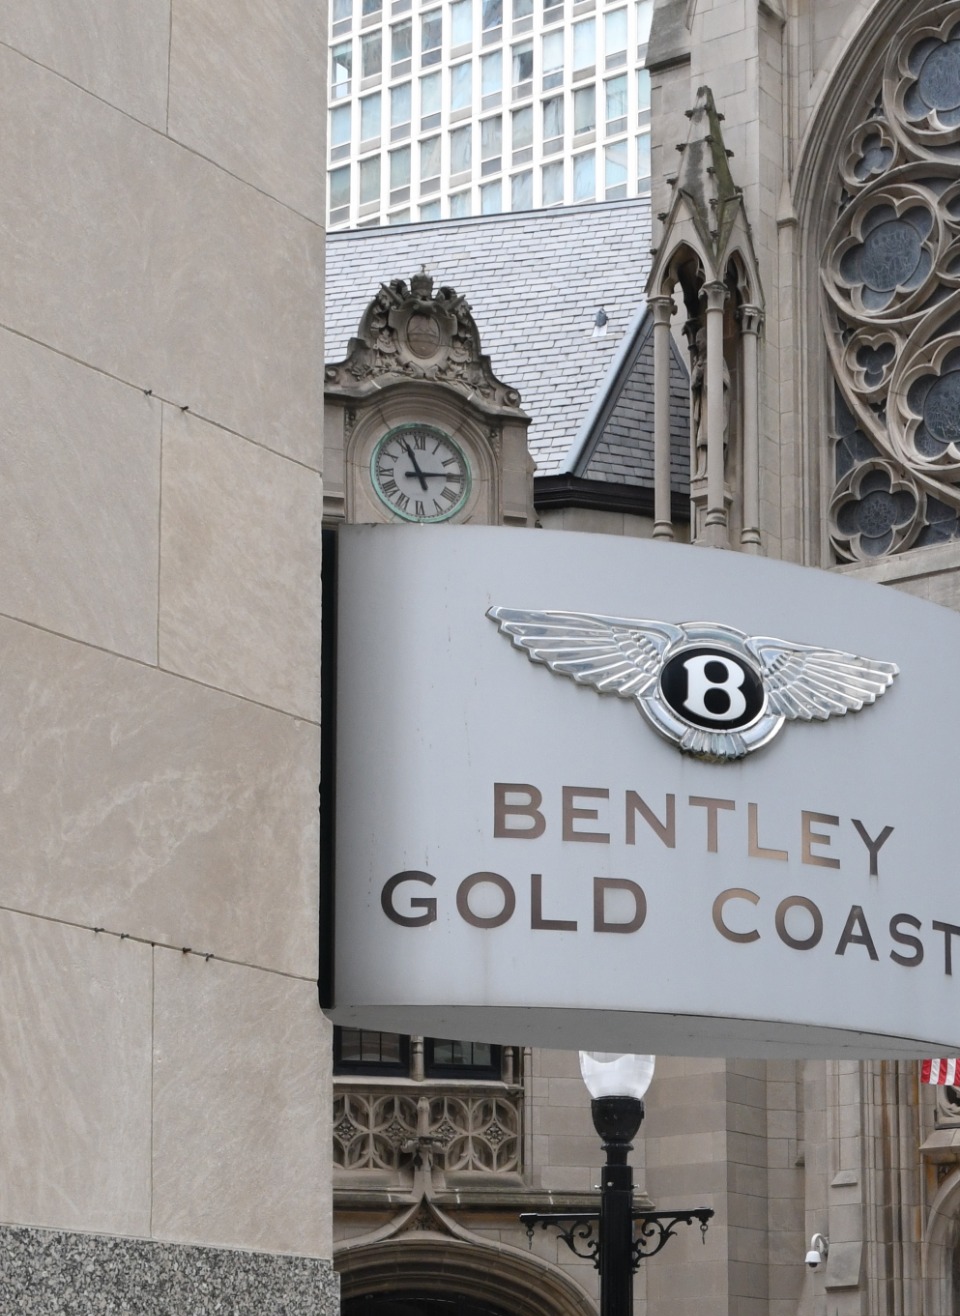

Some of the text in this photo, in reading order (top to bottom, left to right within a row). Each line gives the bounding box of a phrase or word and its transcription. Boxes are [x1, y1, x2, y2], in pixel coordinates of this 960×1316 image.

[683, 654, 747, 722] B
[493, 782, 895, 877] BENTLEY
[380, 869, 647, 934] GOLD
